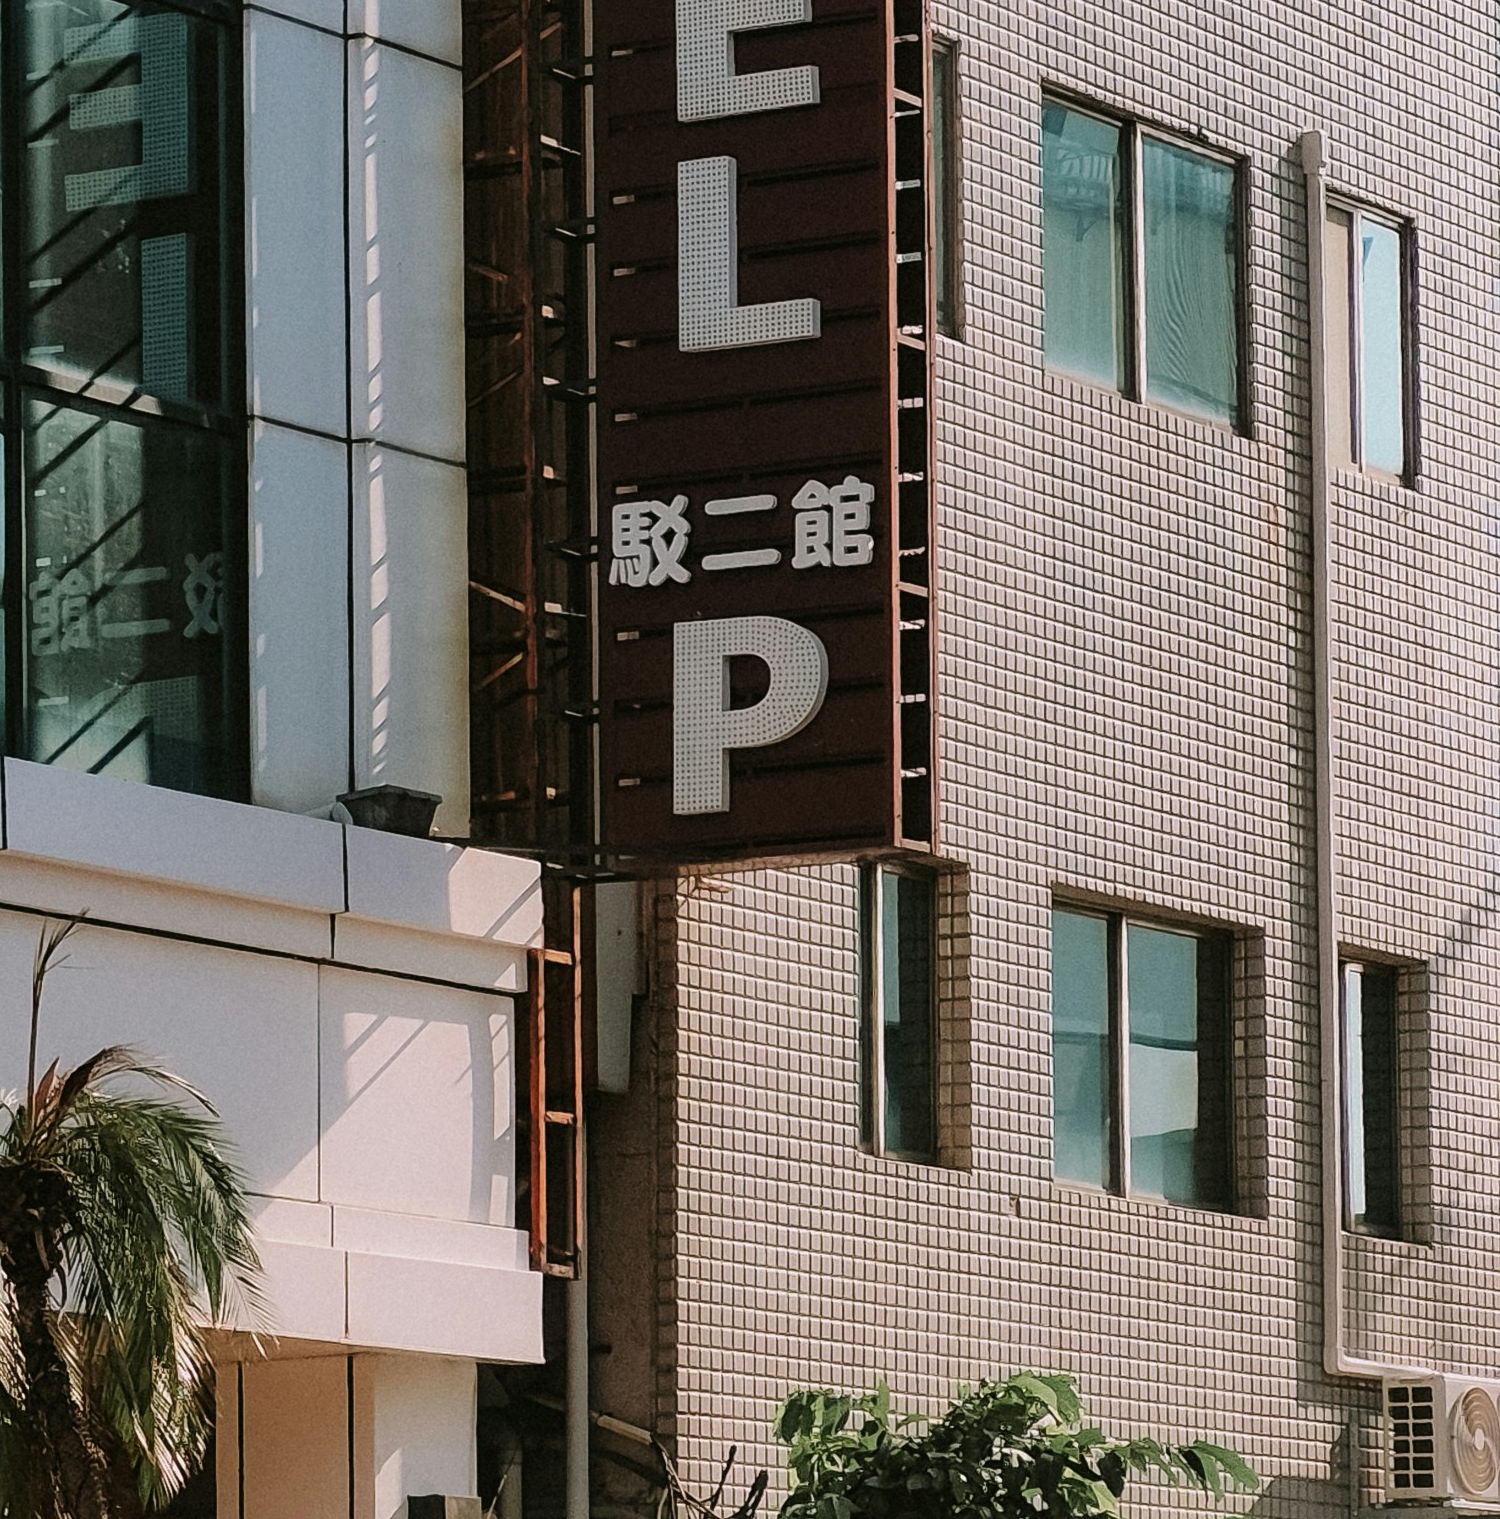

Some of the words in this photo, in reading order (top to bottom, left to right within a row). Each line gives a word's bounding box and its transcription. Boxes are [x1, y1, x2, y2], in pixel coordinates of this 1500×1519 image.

[608, 475, 875, 588] 駁二館
[672, 615, 830, 816] P
